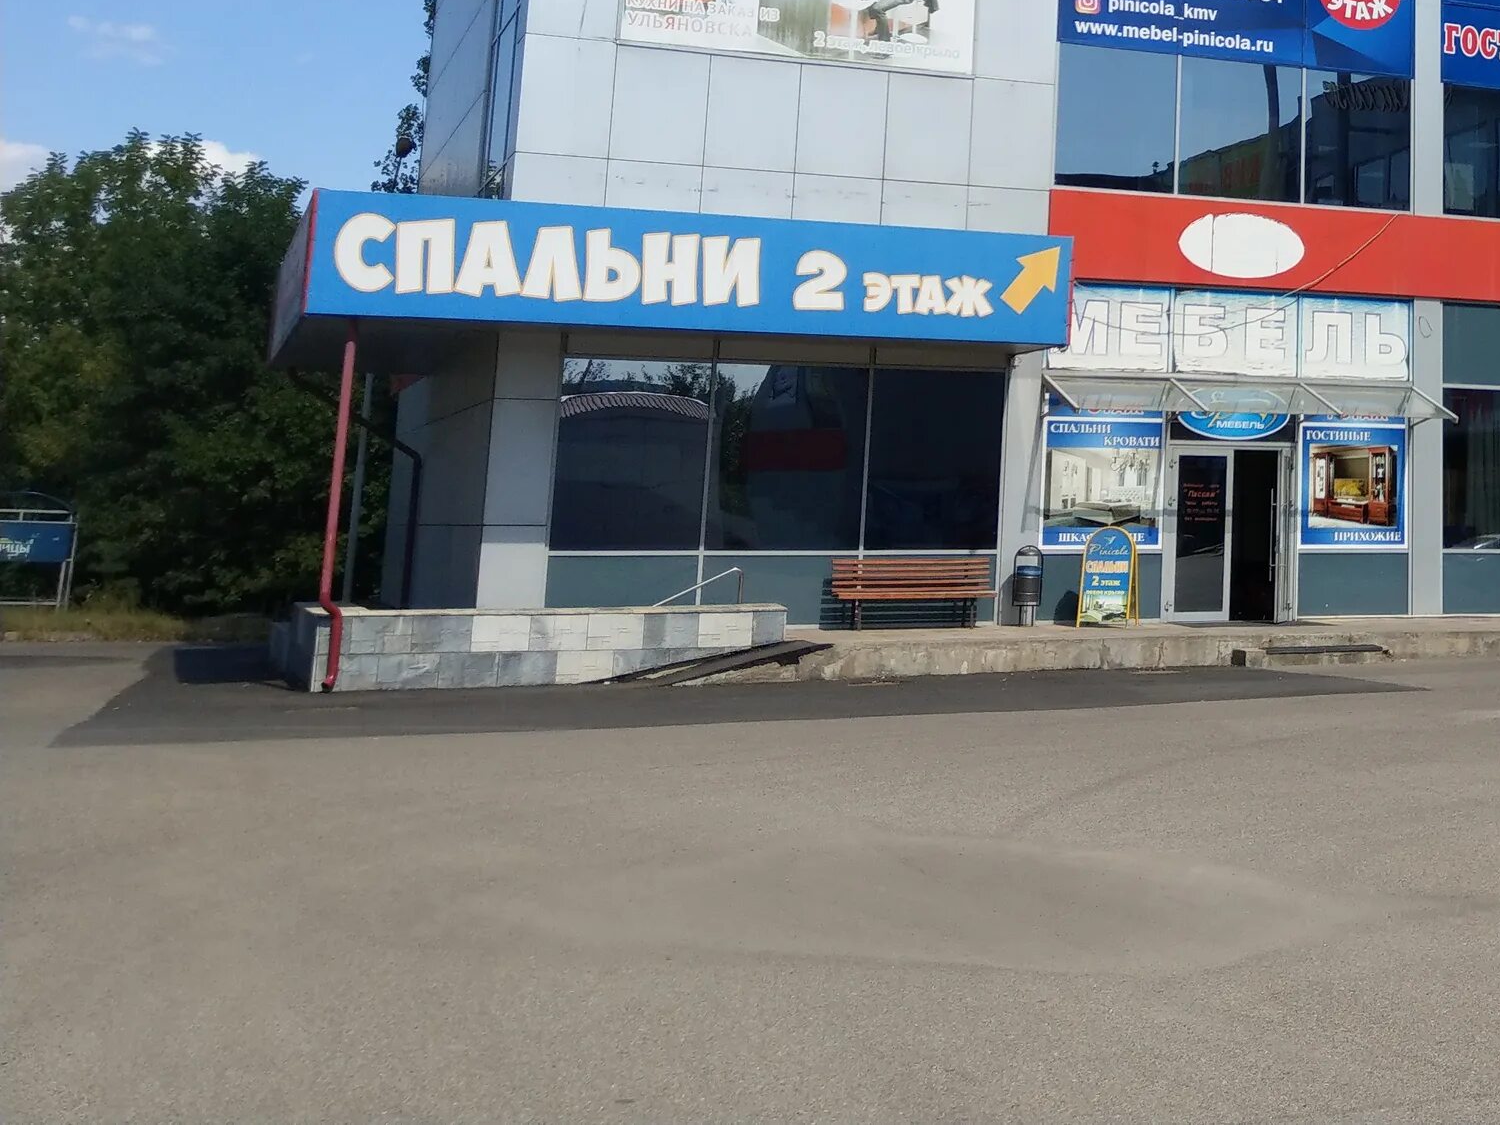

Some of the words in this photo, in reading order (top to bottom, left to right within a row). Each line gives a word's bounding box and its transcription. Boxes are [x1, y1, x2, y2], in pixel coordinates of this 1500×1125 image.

[760, 8, 780, 22] ИЗ
[627, 11, 753, 37] УЛЬЯНОВСКА
[814, 31, 825, 47] 2
[1075, 20, 1274, 54] www.mebel-pinicola.ru
[333, 212, 761, 308] СПАЛЬНИ
[792, 250, 848, 311] 2
[1070, 298, 1408, 365] МЕБЕЛЬ
[1050, 422, 1111, 434] СПАЛЬНИ
[1216, 420, 1265, 430] МЕБЕЛЬ
[1103, 435, 1160, 447] КРОВАТИ
[1333, 531, 1402, 543] ПРИХОЖИЕ
[1091, 576, 1100, 586] 2
